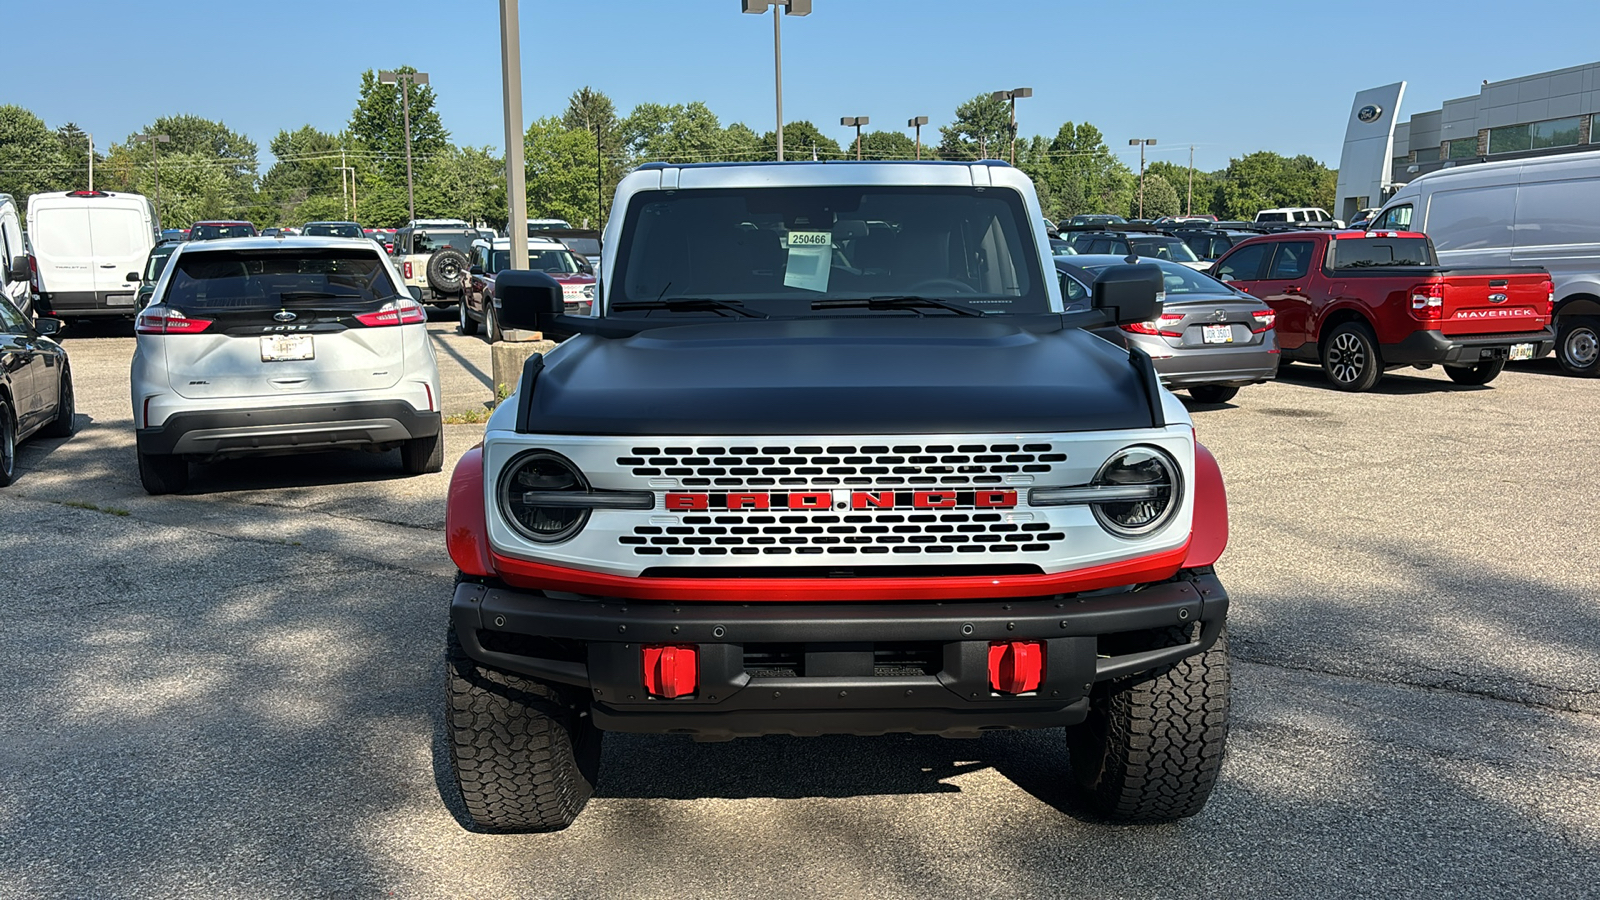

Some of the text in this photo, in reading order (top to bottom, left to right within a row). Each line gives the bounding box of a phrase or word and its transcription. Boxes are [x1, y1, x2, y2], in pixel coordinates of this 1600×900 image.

[792, 234, 826, 244] 250466
[1457, 309, 1531, 319] MAVERICK
[665, 490, 1017, 510] BRONCO
